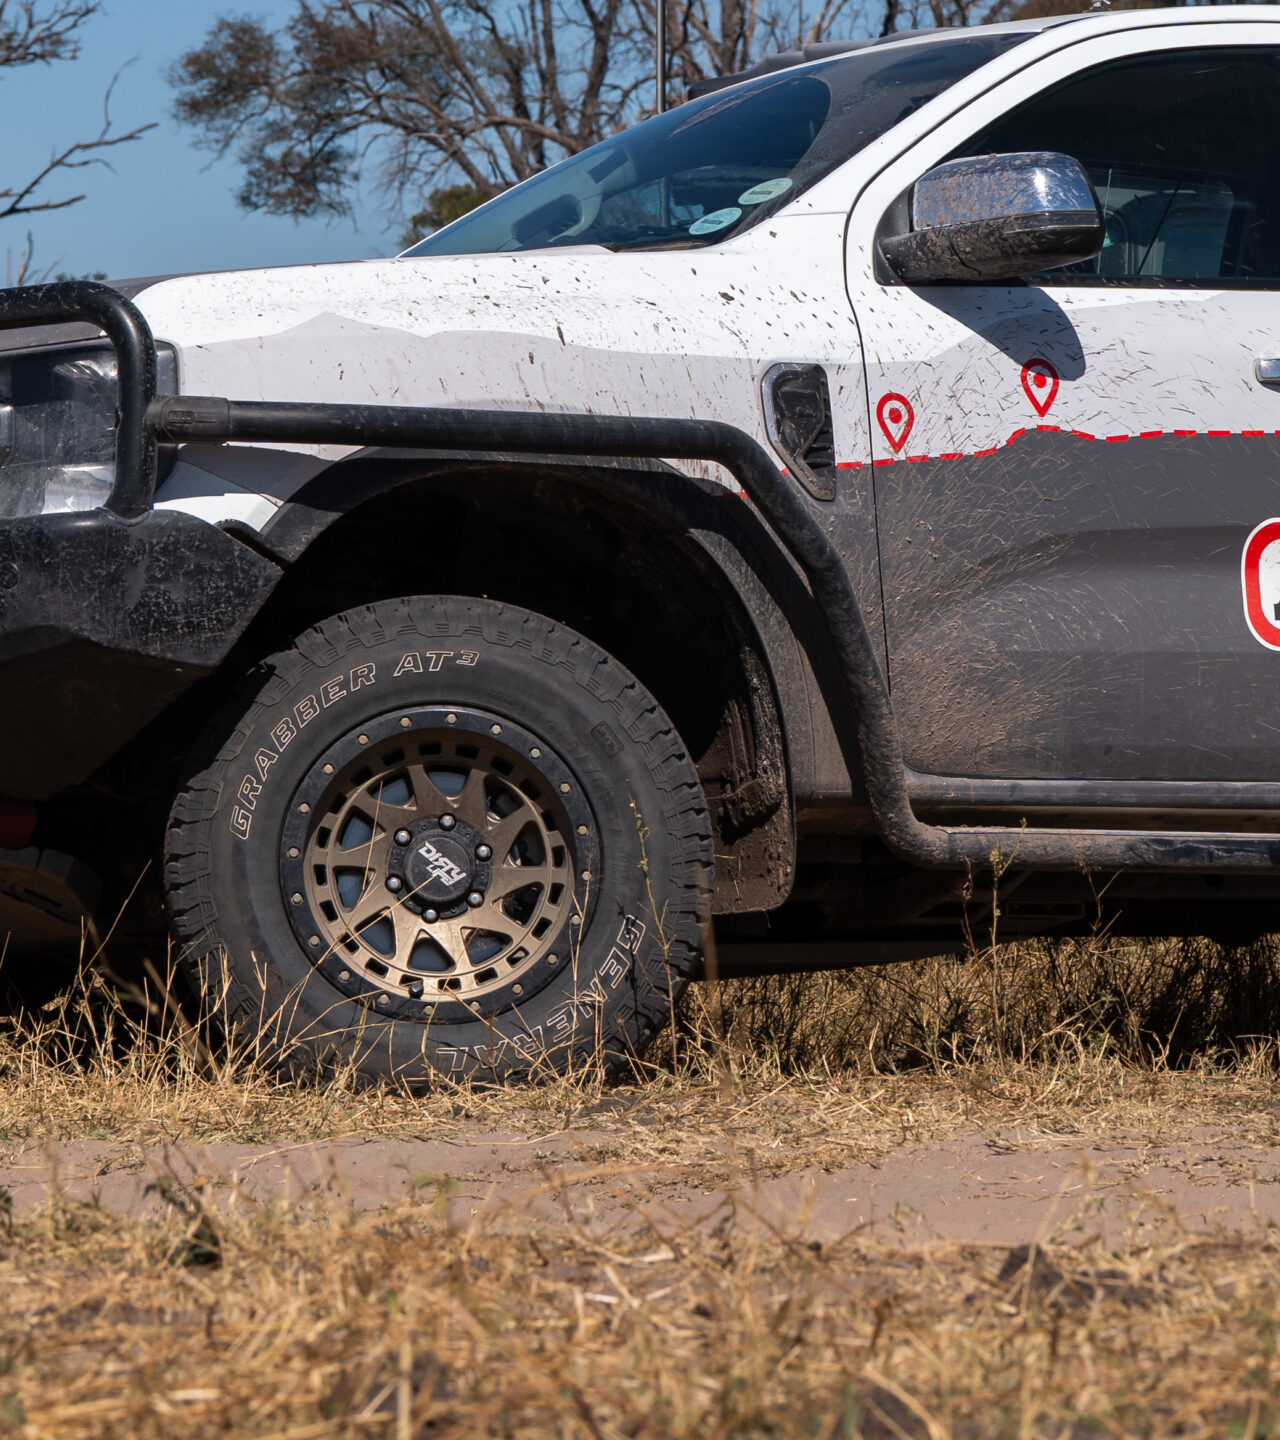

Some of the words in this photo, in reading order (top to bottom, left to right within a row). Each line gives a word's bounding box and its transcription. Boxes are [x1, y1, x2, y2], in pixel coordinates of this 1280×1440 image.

[229, 662, 376, 840] GRABBER
[418, 841, 467, 881] DIRTY
[435, 914, 647, 1072] GENERAL
